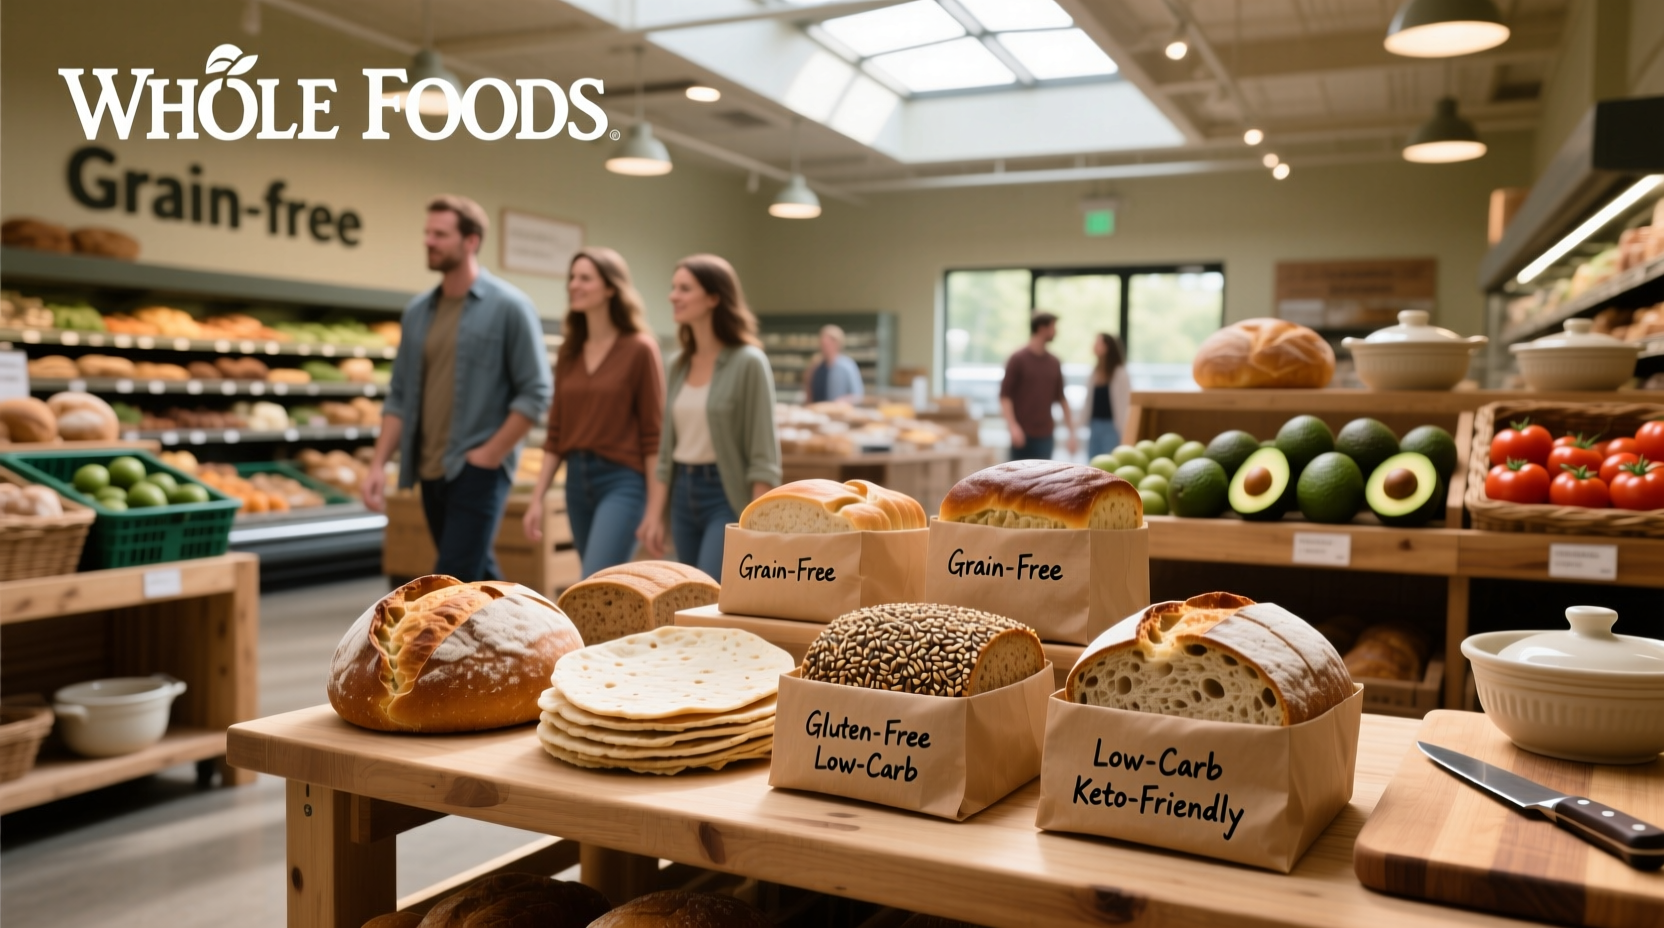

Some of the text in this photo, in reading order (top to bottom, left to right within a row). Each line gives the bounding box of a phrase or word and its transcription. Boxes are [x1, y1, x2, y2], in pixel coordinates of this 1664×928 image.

[66, 146, 363, 248] Grain-free
[739, 552, 837, 582] Grain-Free
[947, 548, 1064, 581] Grain-Free
[805, 709, 932, 749] Gluten-Free
[814, 744, 919, 783] Low-Carb
[1093, 737, 1224, 782] Low-Carb
[1072, 774, 1245, 842] Keto-Friendly
